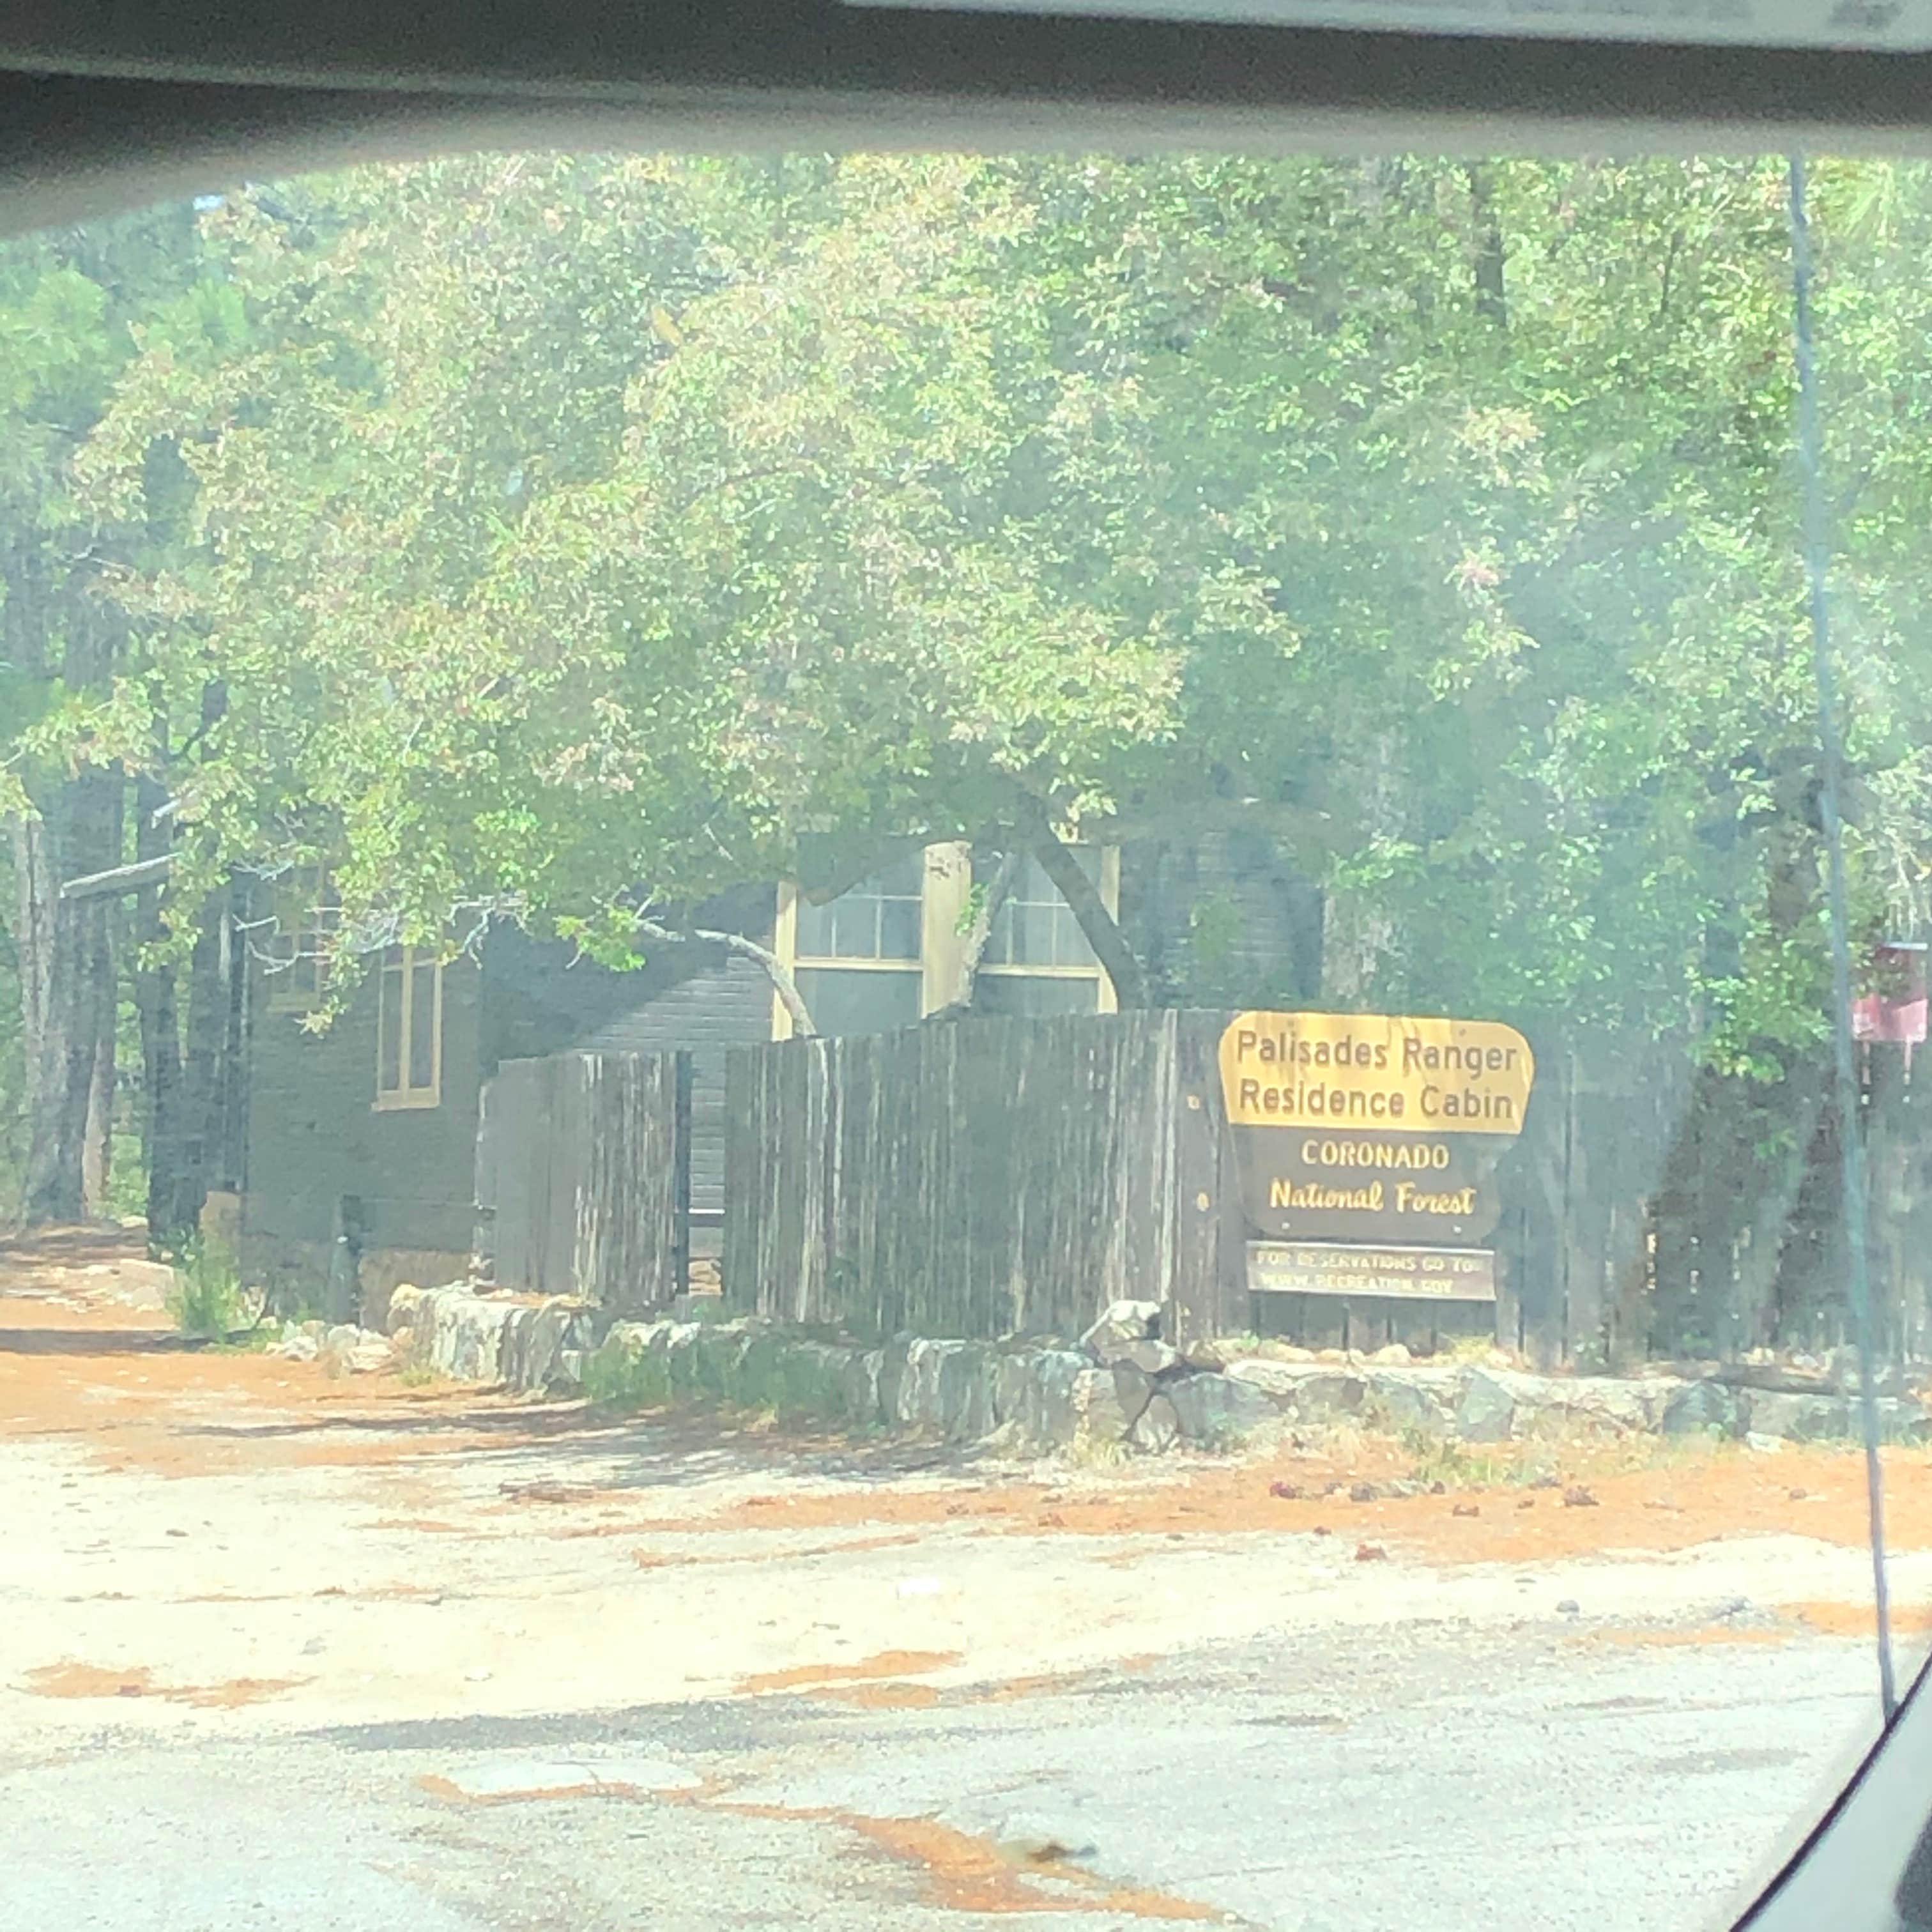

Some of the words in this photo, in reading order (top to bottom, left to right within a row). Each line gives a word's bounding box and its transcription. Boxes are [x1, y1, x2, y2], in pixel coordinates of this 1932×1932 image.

[1238, 1030, 1388, 1068] Palisades
[1402, 1036, 1518, 1080] Ranger
[1239, 1078, 1405, 1118] Residence
[1420, 1085, 1514, 1119] Cabin
[1301, 1139, 1450, 1169] CORONADO
[1269, 1177, 1384, 1212] National
[1394, 1182, 1477, 1215] Forest
[1257, 1250, 1290, 1266] FOR
